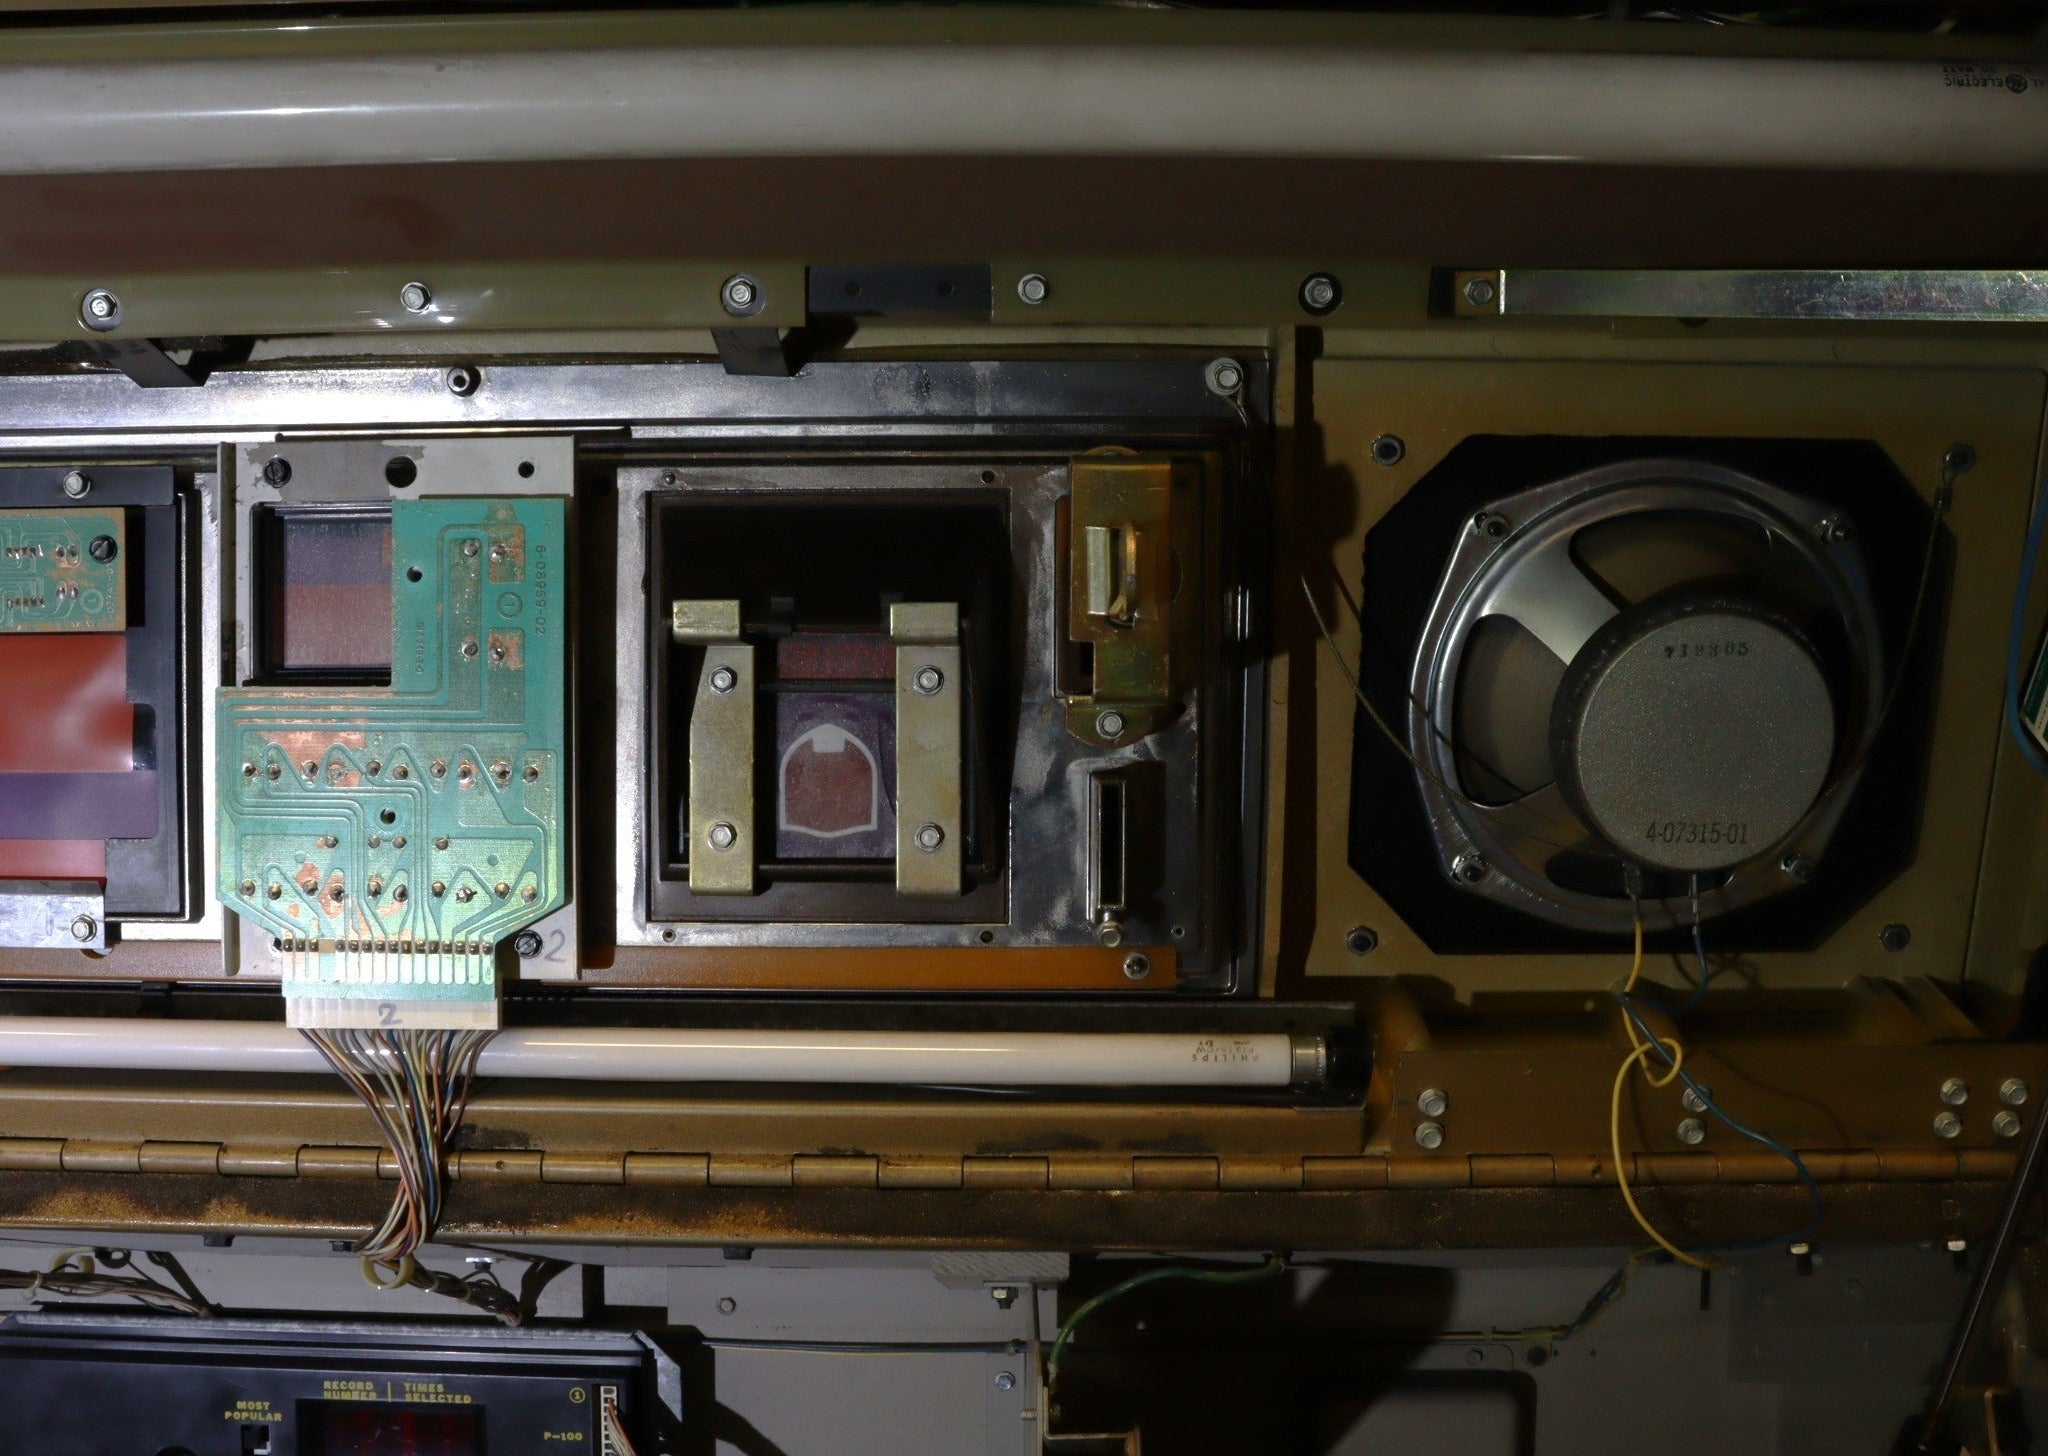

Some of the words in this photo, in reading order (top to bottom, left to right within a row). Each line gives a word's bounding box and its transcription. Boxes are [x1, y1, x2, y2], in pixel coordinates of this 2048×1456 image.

[1943, 77, 2004, 88] ELECTRIC
[535, 545, 546, 635] 6-08959-02
[1645, 821, 1748, 845] 4-07315-01
[543, 928, 567, 963] 2
[378, 1003, 403, 1026] 2
[1192, 1053, 1259, 1062] PHILIPS
[323, 1380, 374, 1391] RECORD
[404, 1382, 445, 1393] TIMES
[323, 1391, 378, 1400] NUMBER
[404, 1393, 472, 1404] SELECTED
[236, 1400, 271, 1411] MOST
[224, 1411, 283, 1422] POPULAR
[543, 1431, 583, 1441] P-100
